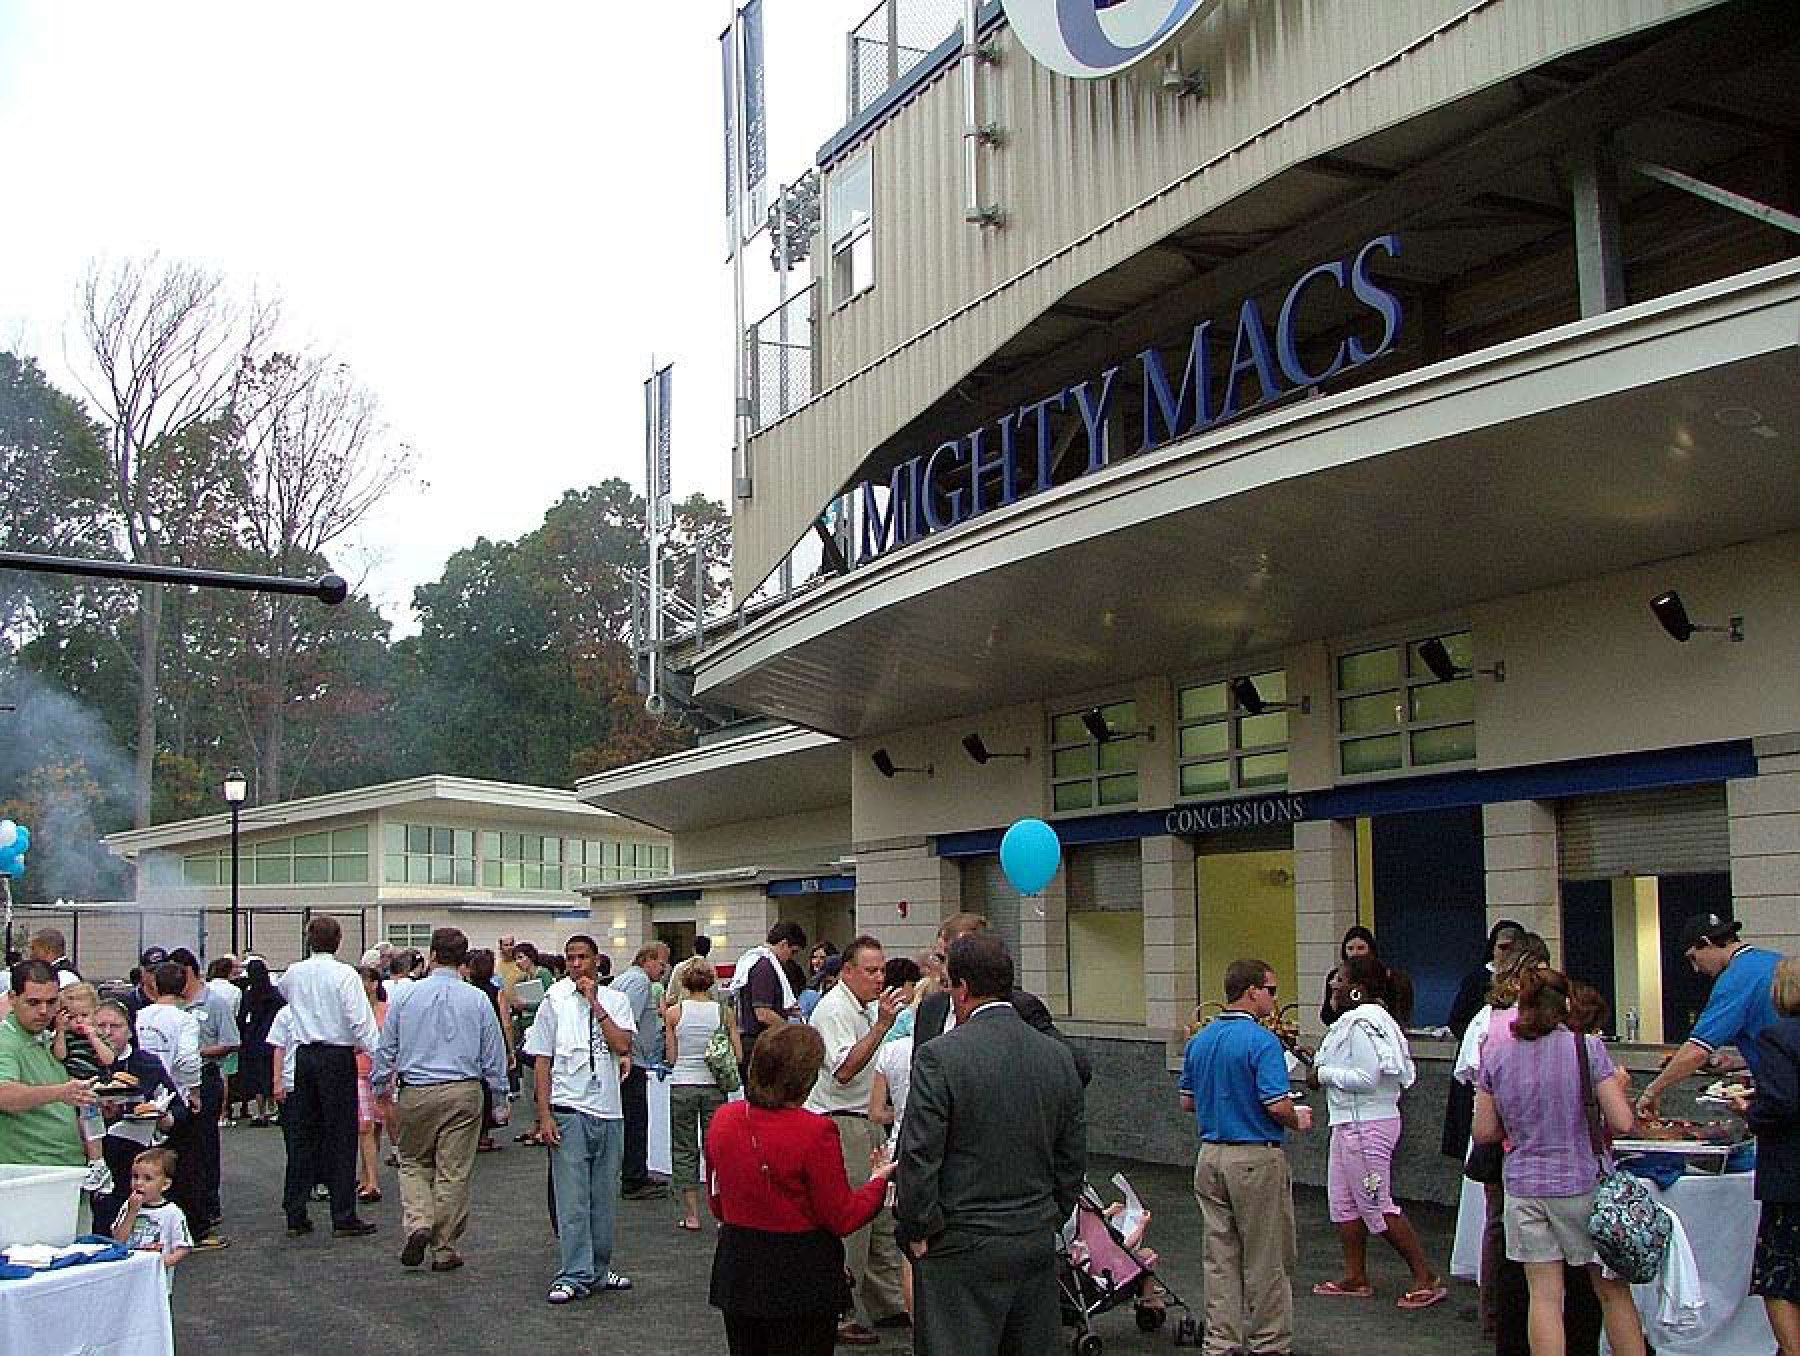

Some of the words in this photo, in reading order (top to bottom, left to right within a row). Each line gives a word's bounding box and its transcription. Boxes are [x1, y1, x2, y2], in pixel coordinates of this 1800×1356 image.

[856, 366, 1120, 564] MIGHTY
[1136, 234, 1403, 456] MACS
[1165, 797, 1304, 833] CONCESSIONS
